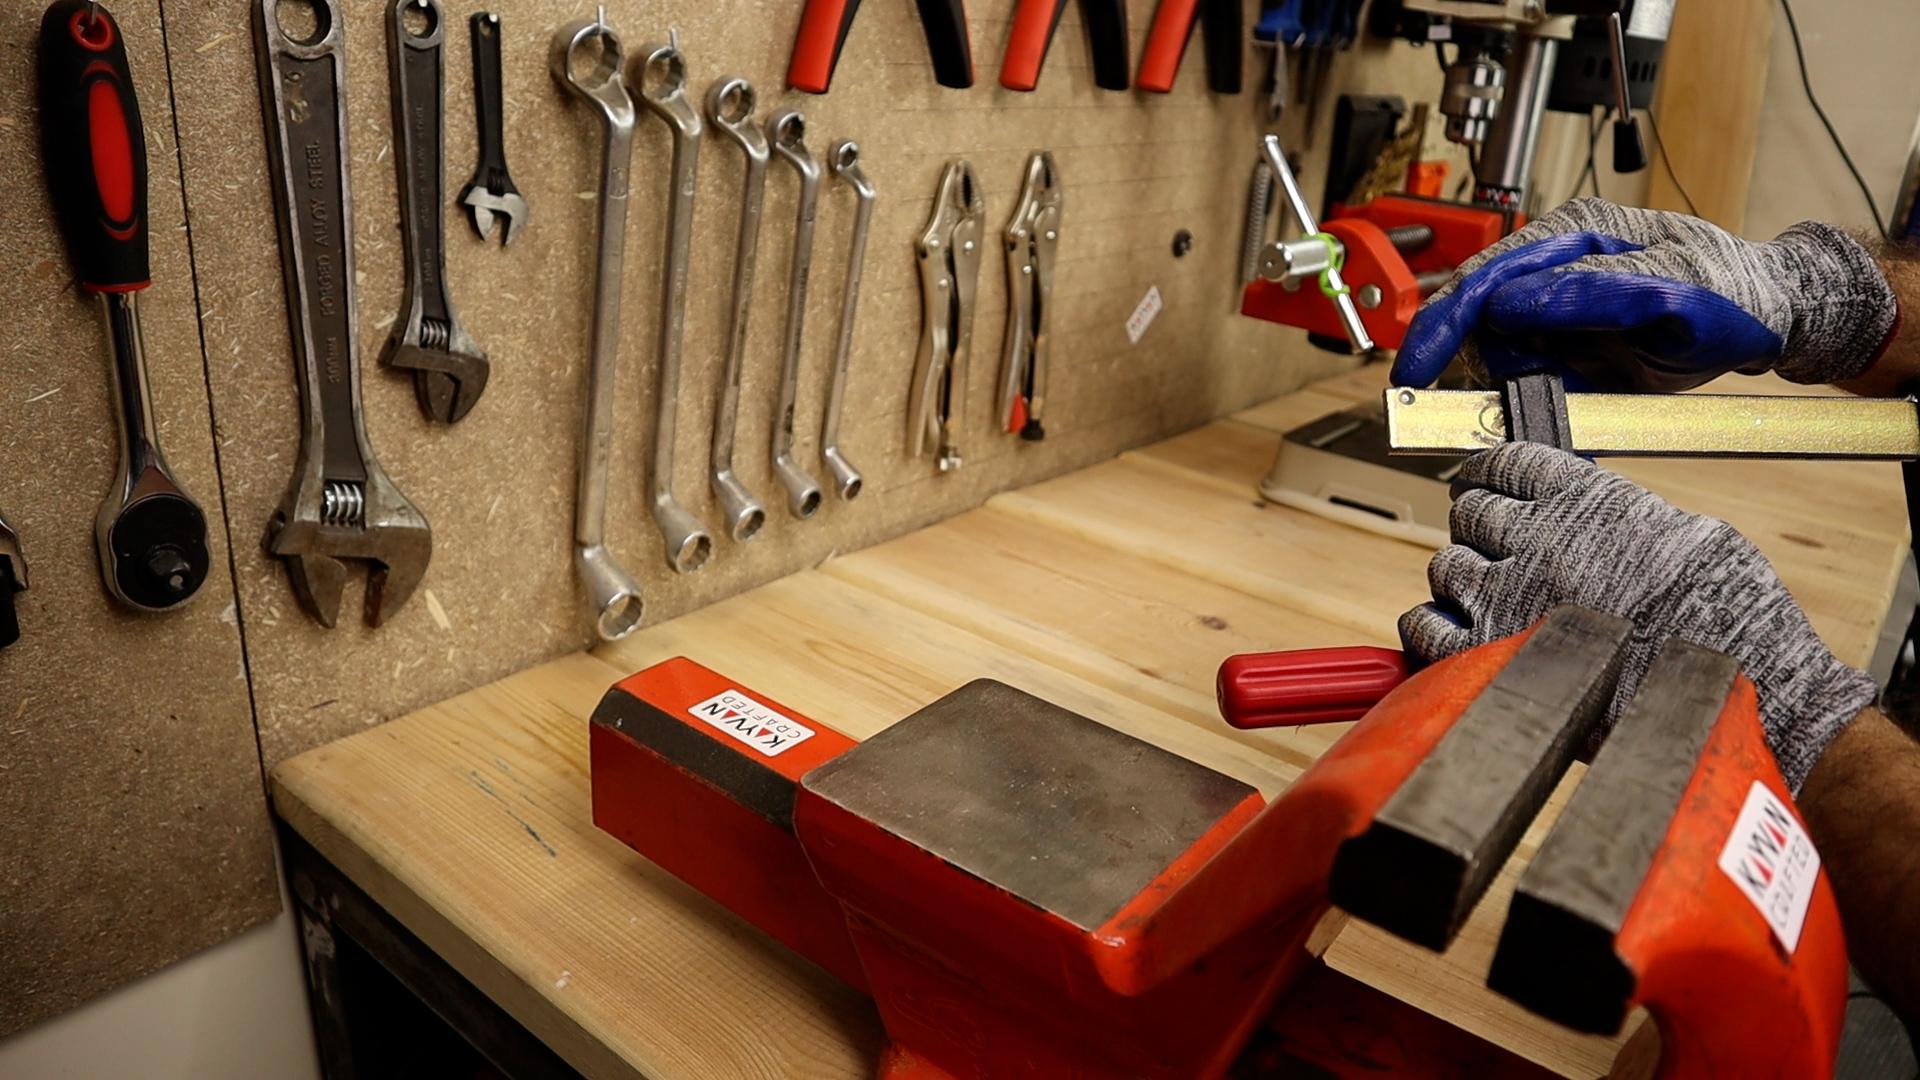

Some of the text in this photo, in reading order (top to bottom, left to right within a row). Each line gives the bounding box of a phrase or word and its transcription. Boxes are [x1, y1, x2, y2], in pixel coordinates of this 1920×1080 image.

[305, 139, 323, 188] STEEL
[311, 198, 329, 248] ALLOY
[316, 254, 335, 317] FORGED
[701, 702, 787, 749] KAYVAN
[721, 695, 801, 739] CRAFTED
[1737, 799, 1791, 898] KAYVAN
